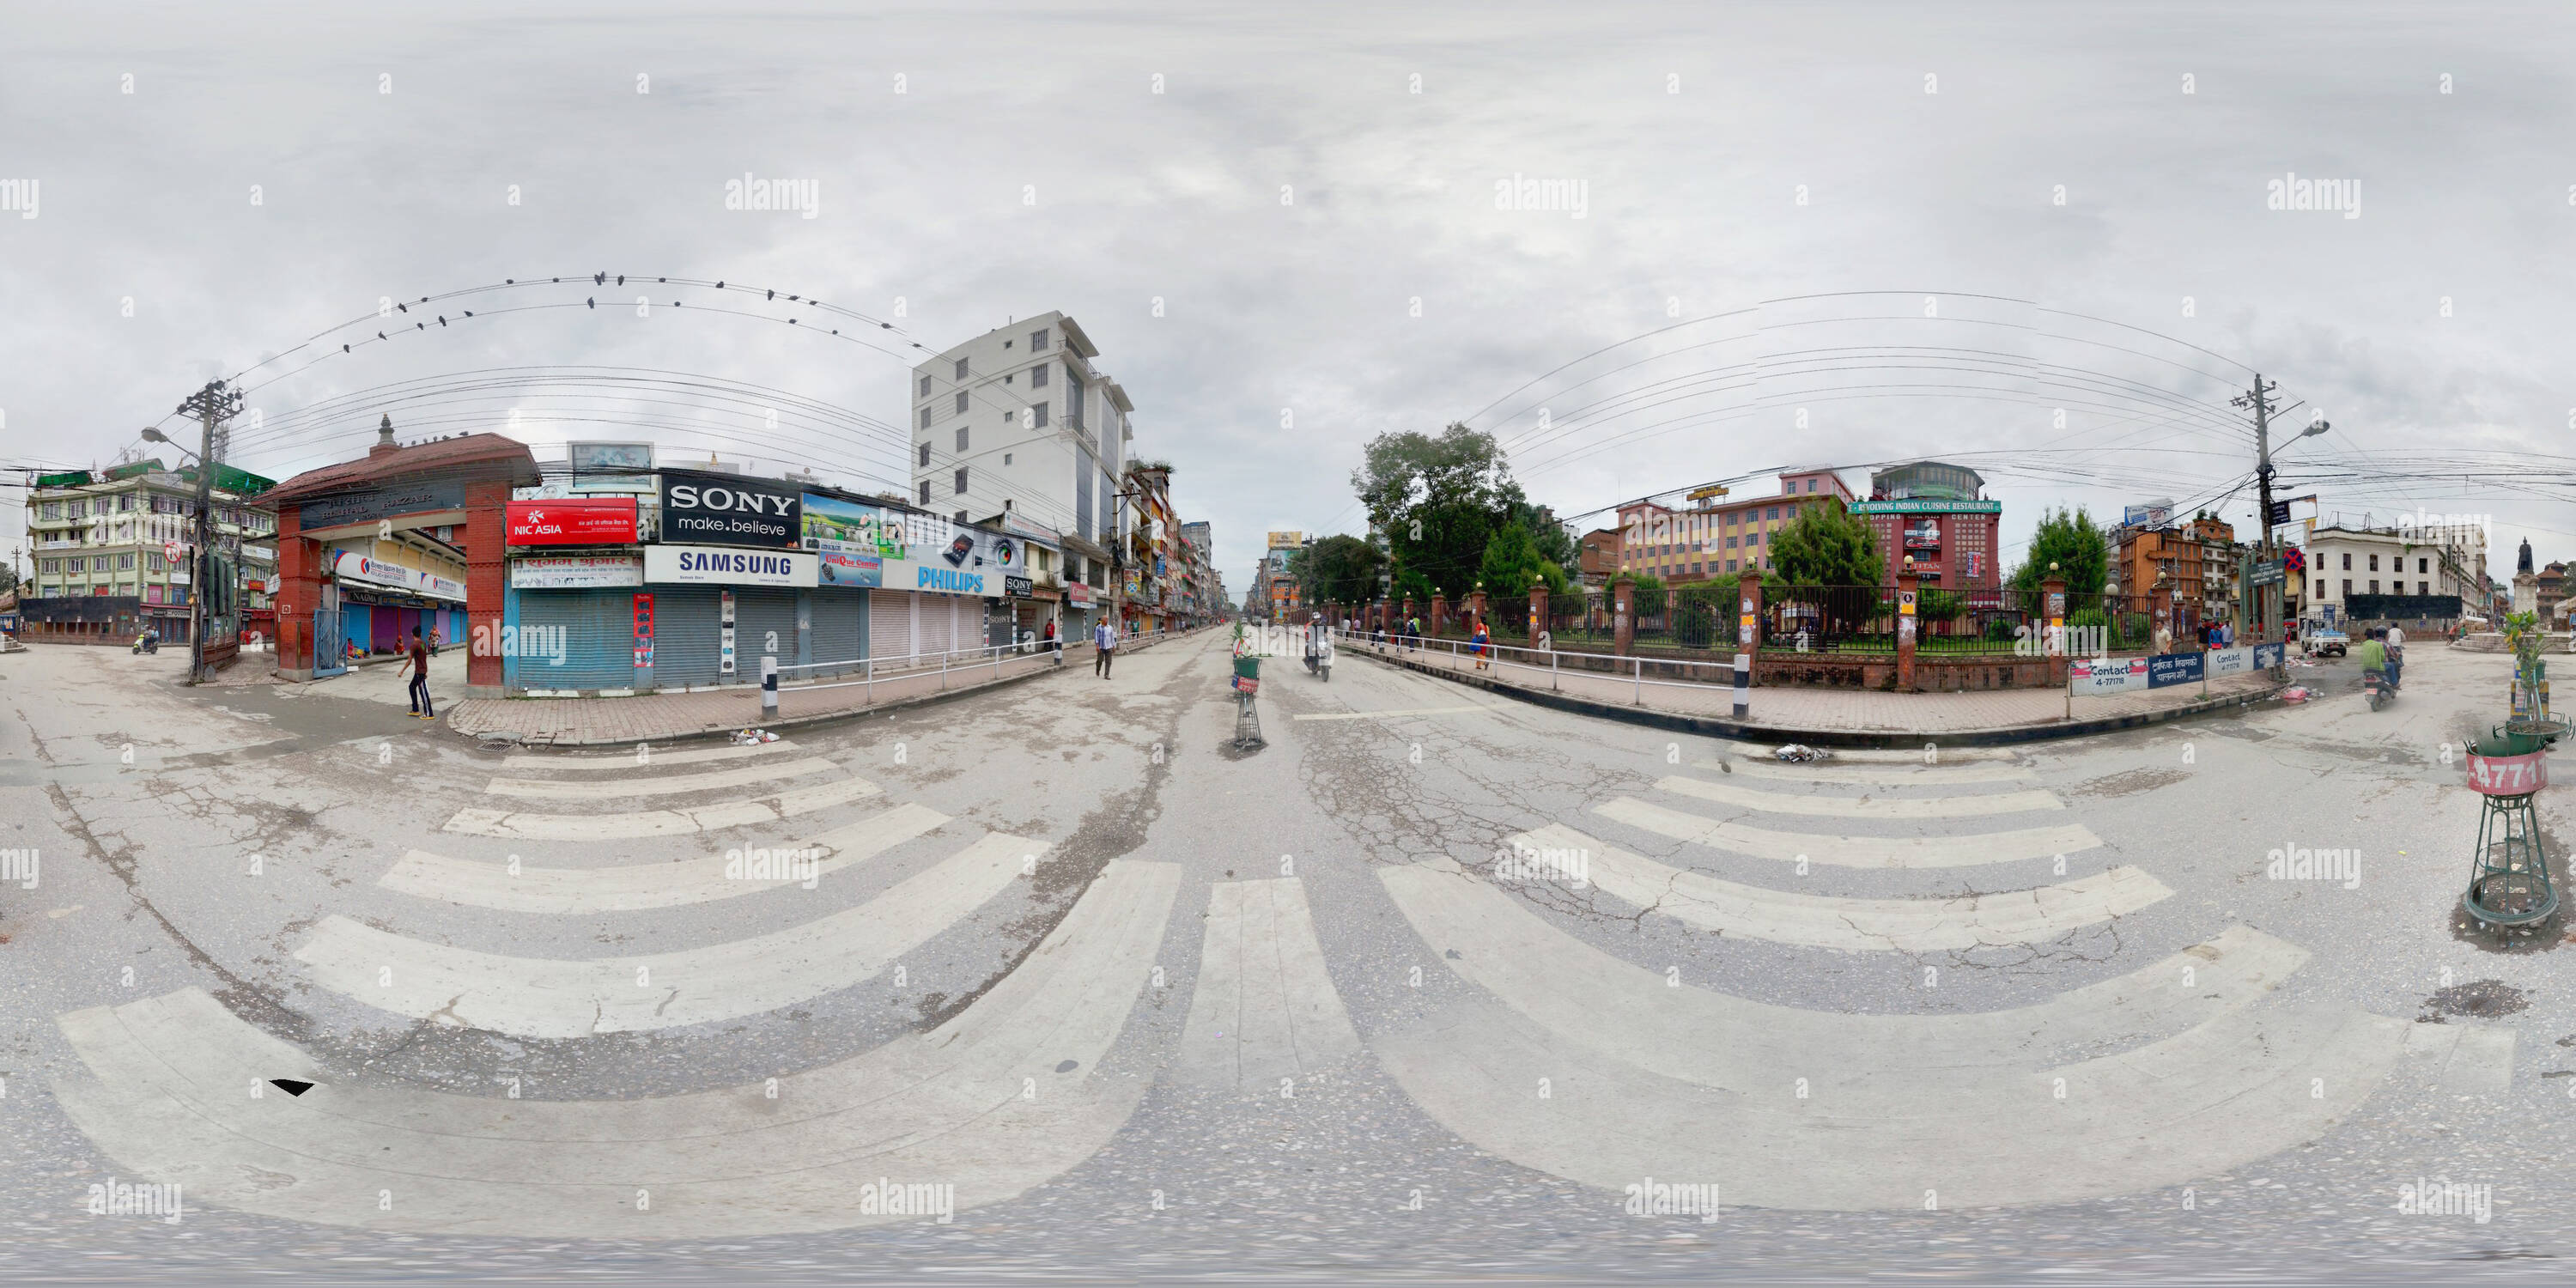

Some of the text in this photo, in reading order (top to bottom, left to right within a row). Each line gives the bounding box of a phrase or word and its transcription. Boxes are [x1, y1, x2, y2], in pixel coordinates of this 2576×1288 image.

[382, 494, 434, 509] BAZAR
[670, 485, 796, 517] SONY
[1858, 502, 1894, 511] REVOLVING
[1895, 501, 1920, 510] INDIAN
[1922, 501, 1951, 510] CUISINE
[1953, 501, 1994, 510] RESTAURANT
[515, 526, 532, 536] NIC
[535, 525, 562, 535] ASIA
[678, 517, 786, 536] make.believe
[679, 552, 791, 575] SAMSUNG
[855, 559, 878, 568] Center
[918, 566, 984, 593] PHILIPS
[1006, 578, 1031, 590] SONY
[2216, 652, 2241, 664] Contact
[2091, 665, 2130, 676] Contact
[2096, 677, 2124, 687] 4-771718
